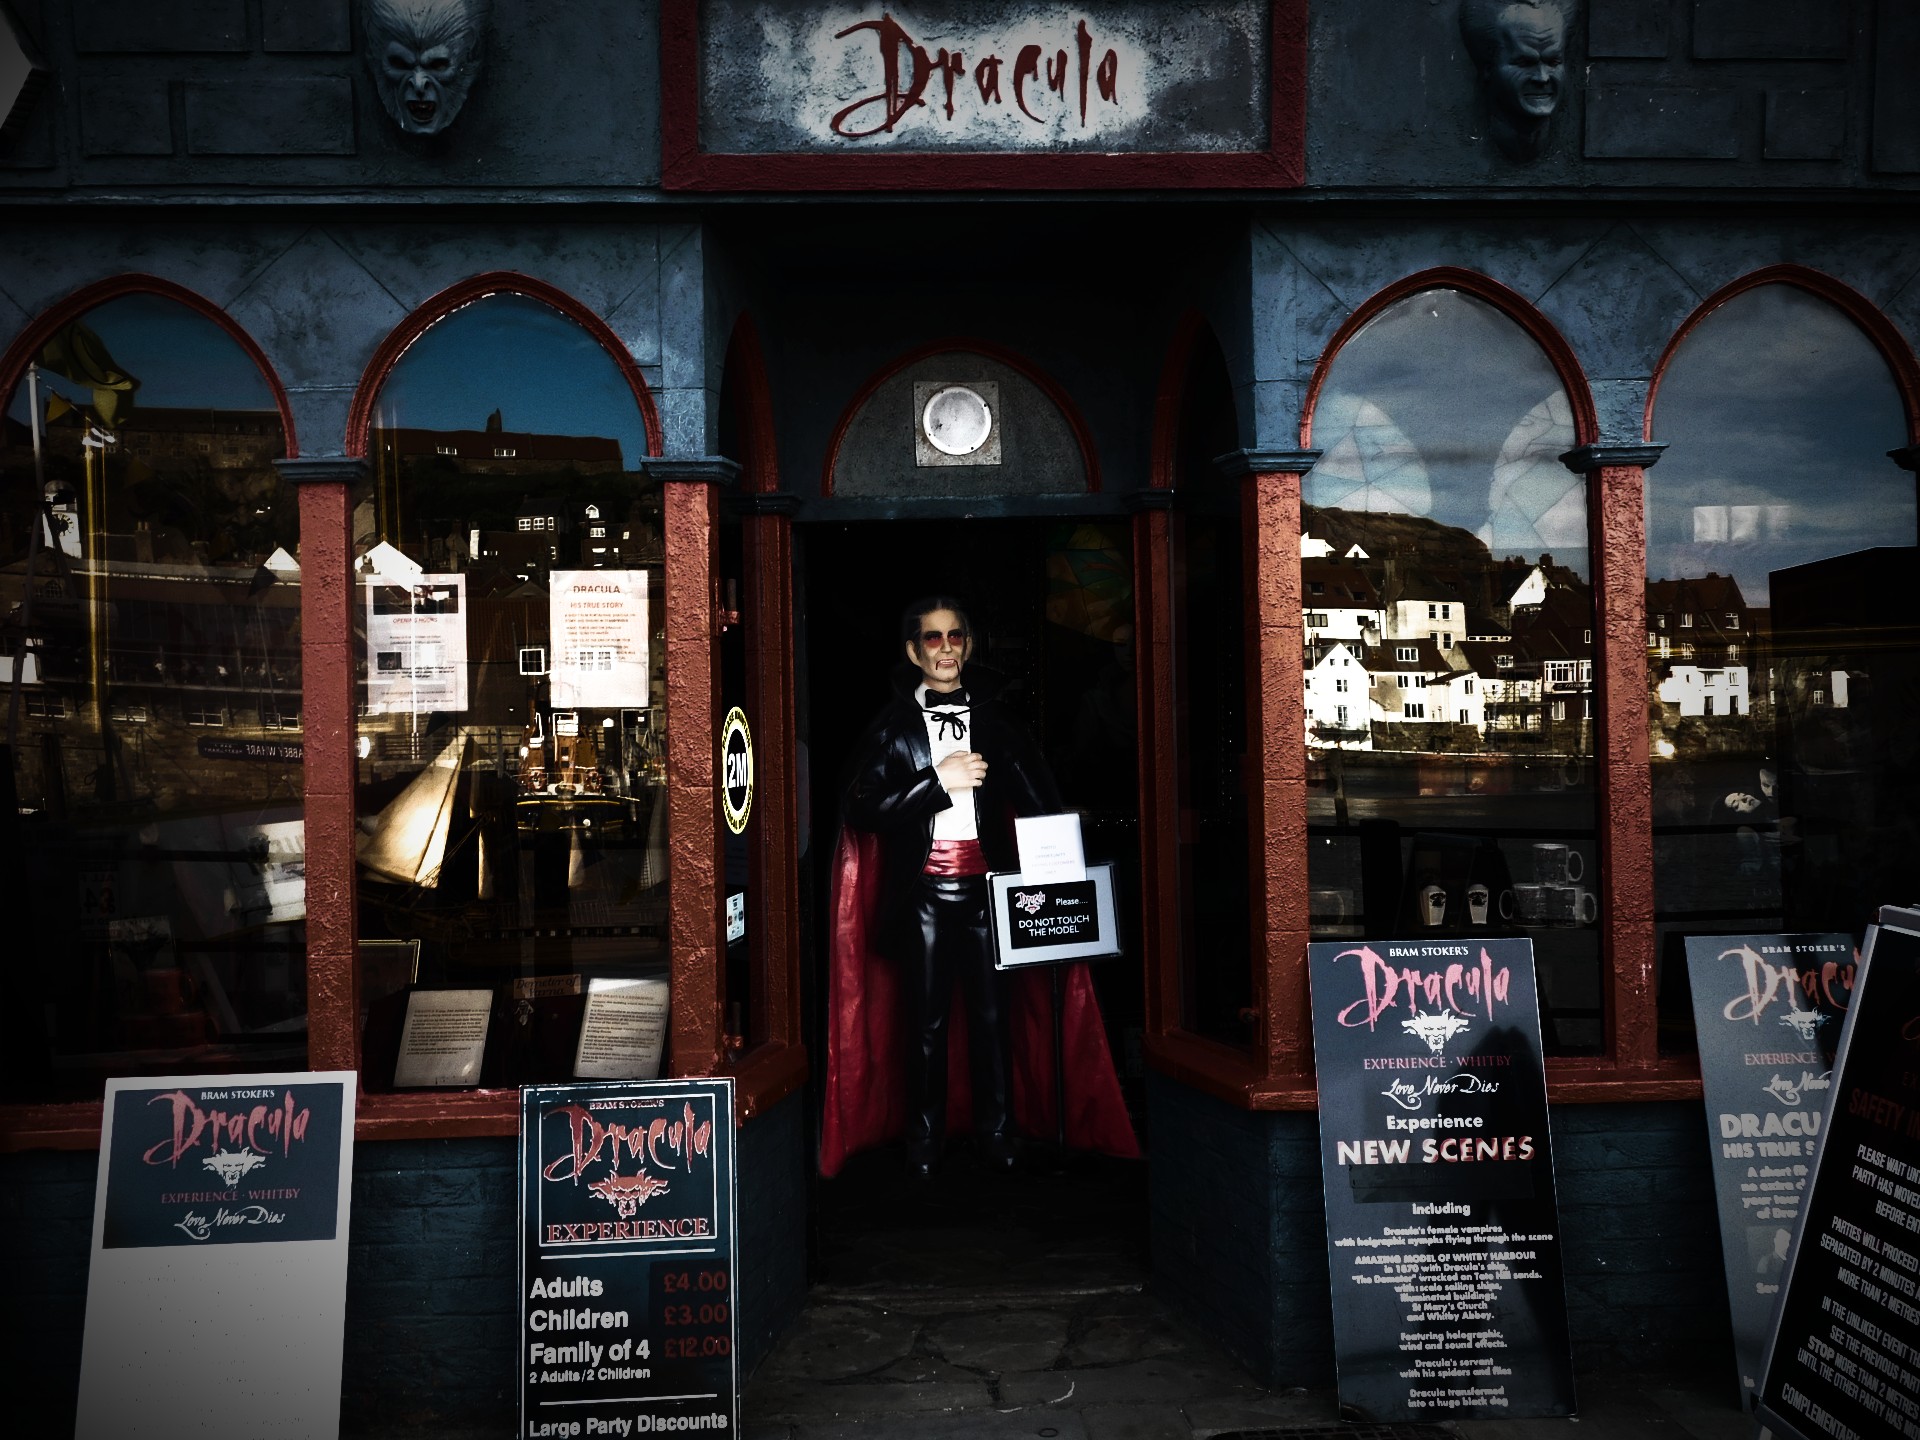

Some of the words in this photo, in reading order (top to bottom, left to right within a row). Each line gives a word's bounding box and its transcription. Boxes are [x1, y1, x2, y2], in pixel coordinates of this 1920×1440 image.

[830, 12, 1118, 138] Dracula
[573, 585, 620, 594] DRACULA
[727, 753, 747, 788] 2M
[1018, 919, 1034, 929] DO
[1034, 917, 1055, 927] NOT
[1056, 914, 1090, 925] TOUCH
[1028, 927, 1047, 937] THE
[1048, 924, 1080, 936] MODEL
[1389, 946, 1419, 957] BRAM
[1421, 946, 1469, 957] STOKER'S
[1761, 946, 1791, 954] BRAM
[1796, 944, 1846, 953] STOKER'S
[1333, 946, 1510, 1032] Dracula
[1363, 1057, 1447, 1070] EXPERIENCE
[1457, 1055, 1512, 1067] WHITBY
[1744, 1051, 1818, 1066] EXPERIENCE
[201, 1091, 228, 1100] BRAM
[230, 1089, 275, 1100] STOKER'S
[1381, 1077, 1422, 1110] Love
[1414, 1074, 1458, 1096] Never
[1445, 1073, 1499, 1093] Dies
[589, 1101, 617, 1110] BRAM
[1847, 1086, 1906, 1132] SAFETY
[143, 1090, 310, 1169] Dracula
[1386, 1114, 1484, 1133] Experience
[543, 1101, 711, 1186] Dracula
[1337, 1139, 1411, 1165] NEW
[1422, 1136, 1535, 1163] SCENES
[1722, 1142, 1755, 1158] HIS
[1757, 1141, 1801, 1157] TRUE
[1857, 1144, 1886, 1168] PLEASE
[1886, 1156, 1907, 1177] WAIT
[1852, 1164, 1877, 1188] PARTY
[1876, 1176, 1894, 1196] HAS
[161, 1190, 238, 1204] EXPERIENCE
[248, 1188, 300, 1200] WHITBY
[1412, 1202, 1471, 1216] Including
[1875, 1199, 1907, 1227] BEFORE
[174, 1211, 211, 1240] Love
[204, 1207, 246, 1227] Never
[238, 1205, 286, 1224] Dies
[546, 1217, 710, 1243] EXPERIENCE
[1383, 1225, 1425, 1236] Dracula's
[1426, 1225, 1459, 1235] female
[1461, 1224, 1503, 1235] vampires
[1445, 1234, 1472, 1245] flying
[1473, 1232, 1510, 1244] through
[1511, 1232, 1526, 1241] the
[1528, 1233, 1553, 1241] scene
[1832, 1215, 1862, 1243] PARTIES
[1862, 1231, 1881, 1254] WILL
[1881, 1241, 1919, 1273] PROCEED
[1354, 1255, 1402, 1264] AMAZING
[1403, 1254, 1436, 1263] MODEL
[1437, 1253, 1451, 1262] OF
[1452, 1252, 1488, 1262] WHITBY
[1489, 1251, 1537, 1261] HARBOUR
[1820, 1232, 1861, 1266] SEPARATED
[1861, 1255, 1873, 1272] BY
[1872, 1261, 1880, 1277] 2
[1879, 1265, 1916, 1297] MINUTES
[1420, 1263, 1442, 1272] with
[1443, 1262, 1485, 1272] Dracula's
[530, 1276, 604, 1298] Adults
[664, 1271, 727, 1293] £4.00
[1418, 1272, 1459, 1282] wrecked
[1444, 1282, 1475, 1293] sailing
[1837, 1266, 1861, 1291] MORE
[1860, 1278, 1881, 1303] THAN
[1880, 1291, 1889, 1307] 2
[1887, 1294, 1920, 1326] METRES
[1456, 1300, 1488, 1311] Church
[530, 1308, 629, 1331] Children
[664, 1303, 728, 1325] £3.00
[1406, 1312, 1425, 1322] and
[1426, 1312, 1460, 1322] Whitby
[1461, 1310, 1495, 1321] Abbey.
[1821, 1295, 1832, 1312] IN
[1831, 1300, 1847, 1322] THE
[1845, 1310, 1882, 1343] UNLIKELY
[1881, 1331, 1909, 1359] EVENT
[1400, 1331, 1444, 1341] Featuring
[530, 1340, 603, 1367] Family
[609, 1338, 633, 1361] of
[636, 1339, 651, 1360] 4
[664, 1336, 731, 1358] £12.00
[1399, 1341, 1423, 1351] wind
[1424, 1341, 1443, 1350] and
[1444, 1340, 1473, 1349] sound
[1830, 1324, 1846, 1346] SEE
[1845, 1333, 1862, 1356] THE
[1860, 1343, 1900, 1381] PREVIOUS
[1415, 1357, 1458, 1368] Dracula's
[1459, 1357, 1494, 1366] servant
[529, 1371, 537, 1384] 2
[598, 1366, 650, 1380] Children
[1399, 1368, 1421, 1378] with
[1421, 1368, 1436, 1378] his
[1437, 1367, 1471, 1379] spiders
[1472, 1366, 1491, 1376] and
[1807, 1334, 1835, 1361] STOP
[1834, 1352, 1858, 1379] MORE
[1857, 1366, 1880, 1393] THAN
[1878, 1381, 1887, 1398] 2
[1886, 1385, 1919, 1420] METRES
[1409, 1387, 1446, 1398] Dracula
[1797, 1346, 1818, 1373] UNTIL
[1818, 1361, 1835, 1383] THE
[1833, 1372, 1860, 1400] OTHER
[1859, 1388, 1886, 1417] PARTY
[1884, 1406, 1904, 1432] HAS
[1407, 1398, 1427, 1408] into
[1436, 1397, 1461, 1409] huge
[1461, 1396, 1488, 1406] black
[1489, 1395, 1509, 1407] dog
[530, 1418, 581, 1439] Large
[586, 1416, 632, 1438] Party
[637, 1412, 728, 1433] Discounts
